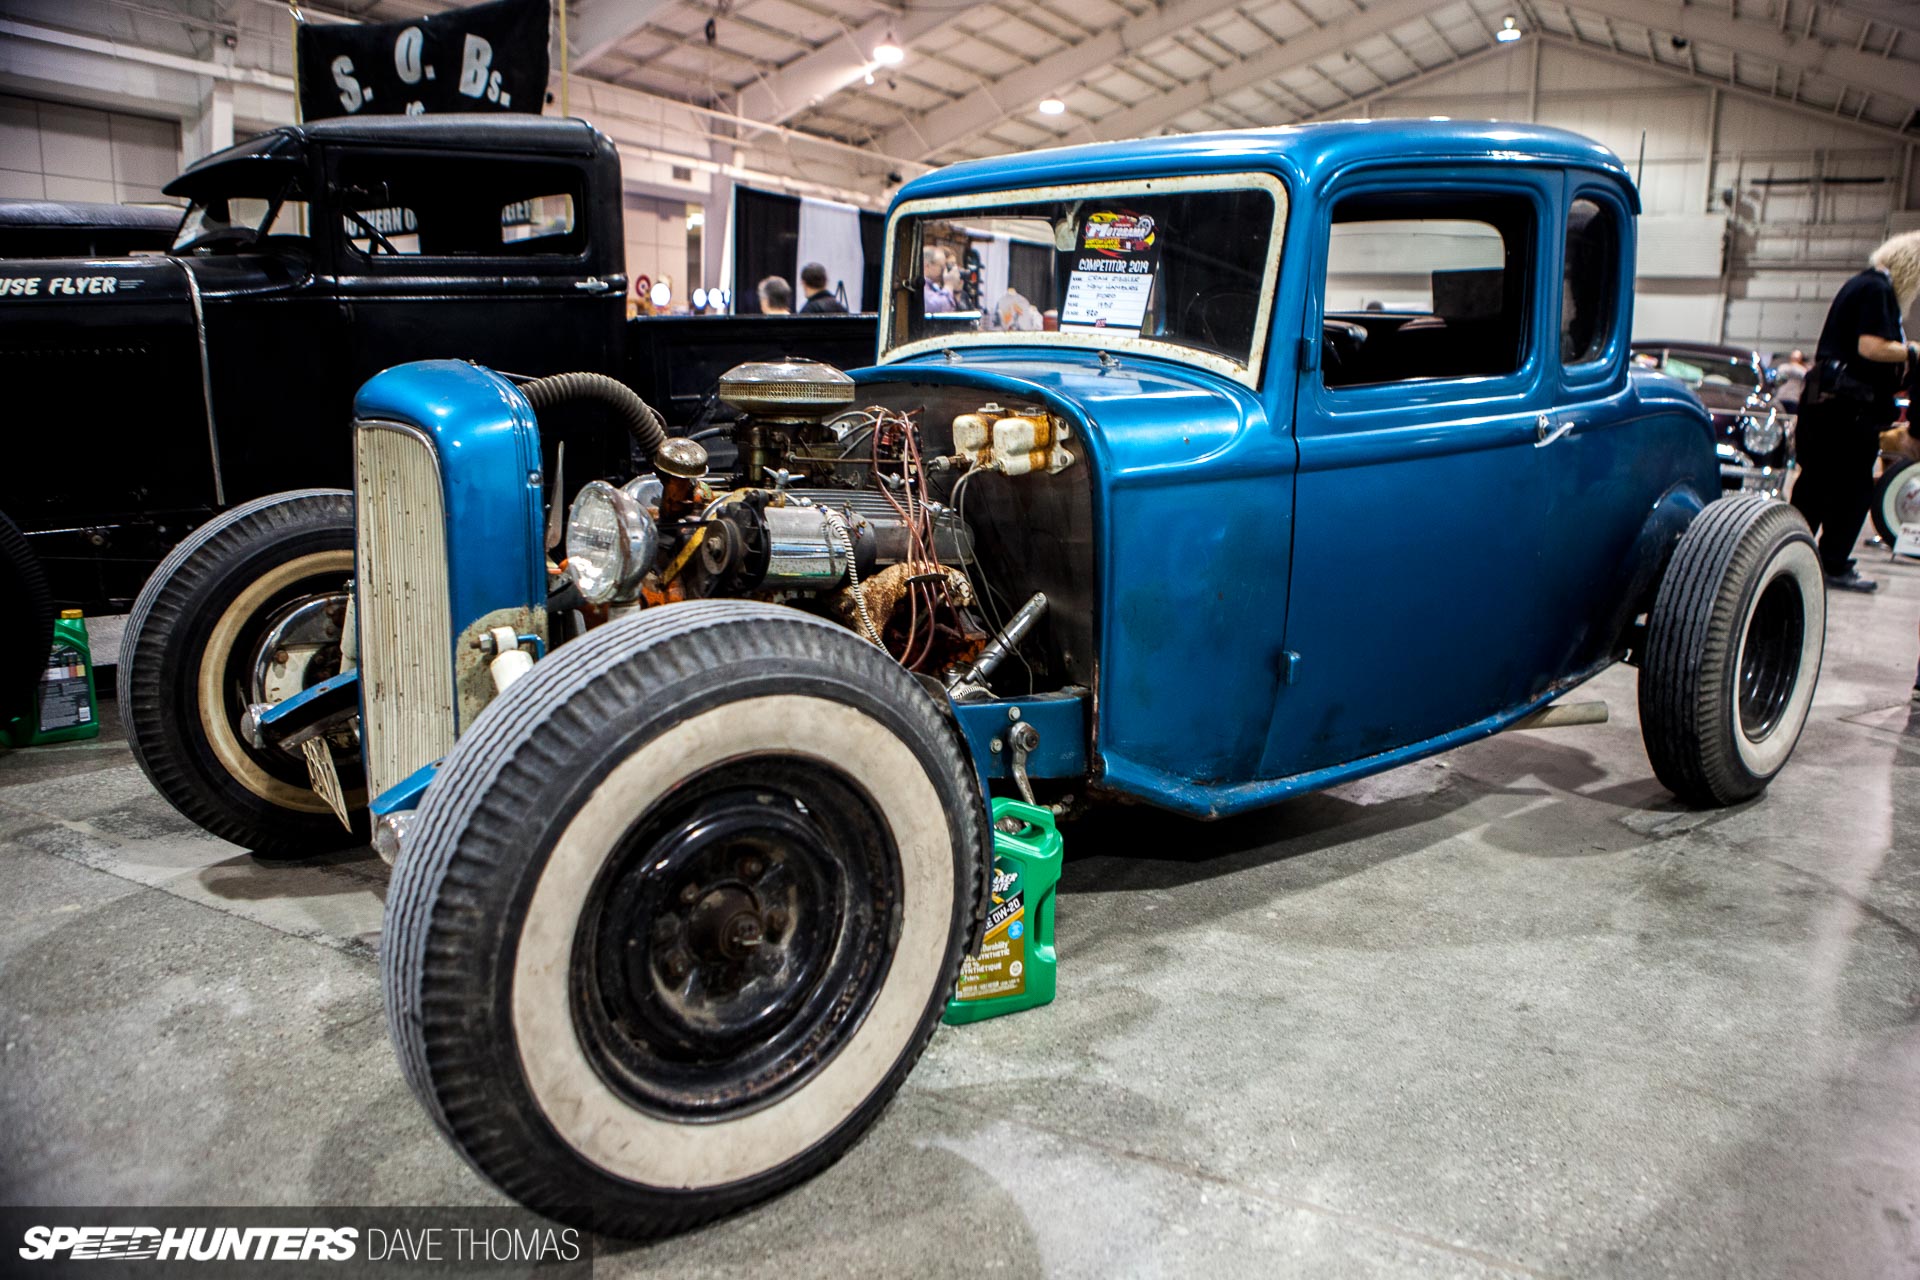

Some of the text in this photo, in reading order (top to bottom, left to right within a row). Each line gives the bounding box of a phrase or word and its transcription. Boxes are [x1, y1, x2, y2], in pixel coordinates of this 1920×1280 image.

[331, 55, 374, 113] S.
[394, 26, 436, 84] O.
[1079, 259, 1149, 273] COMPETITOR 2019
[48, 276, 118, 296] FLYER
[993, 872, 1018, 884] AKER
[992, 897, 1021, 924] 0W-20
